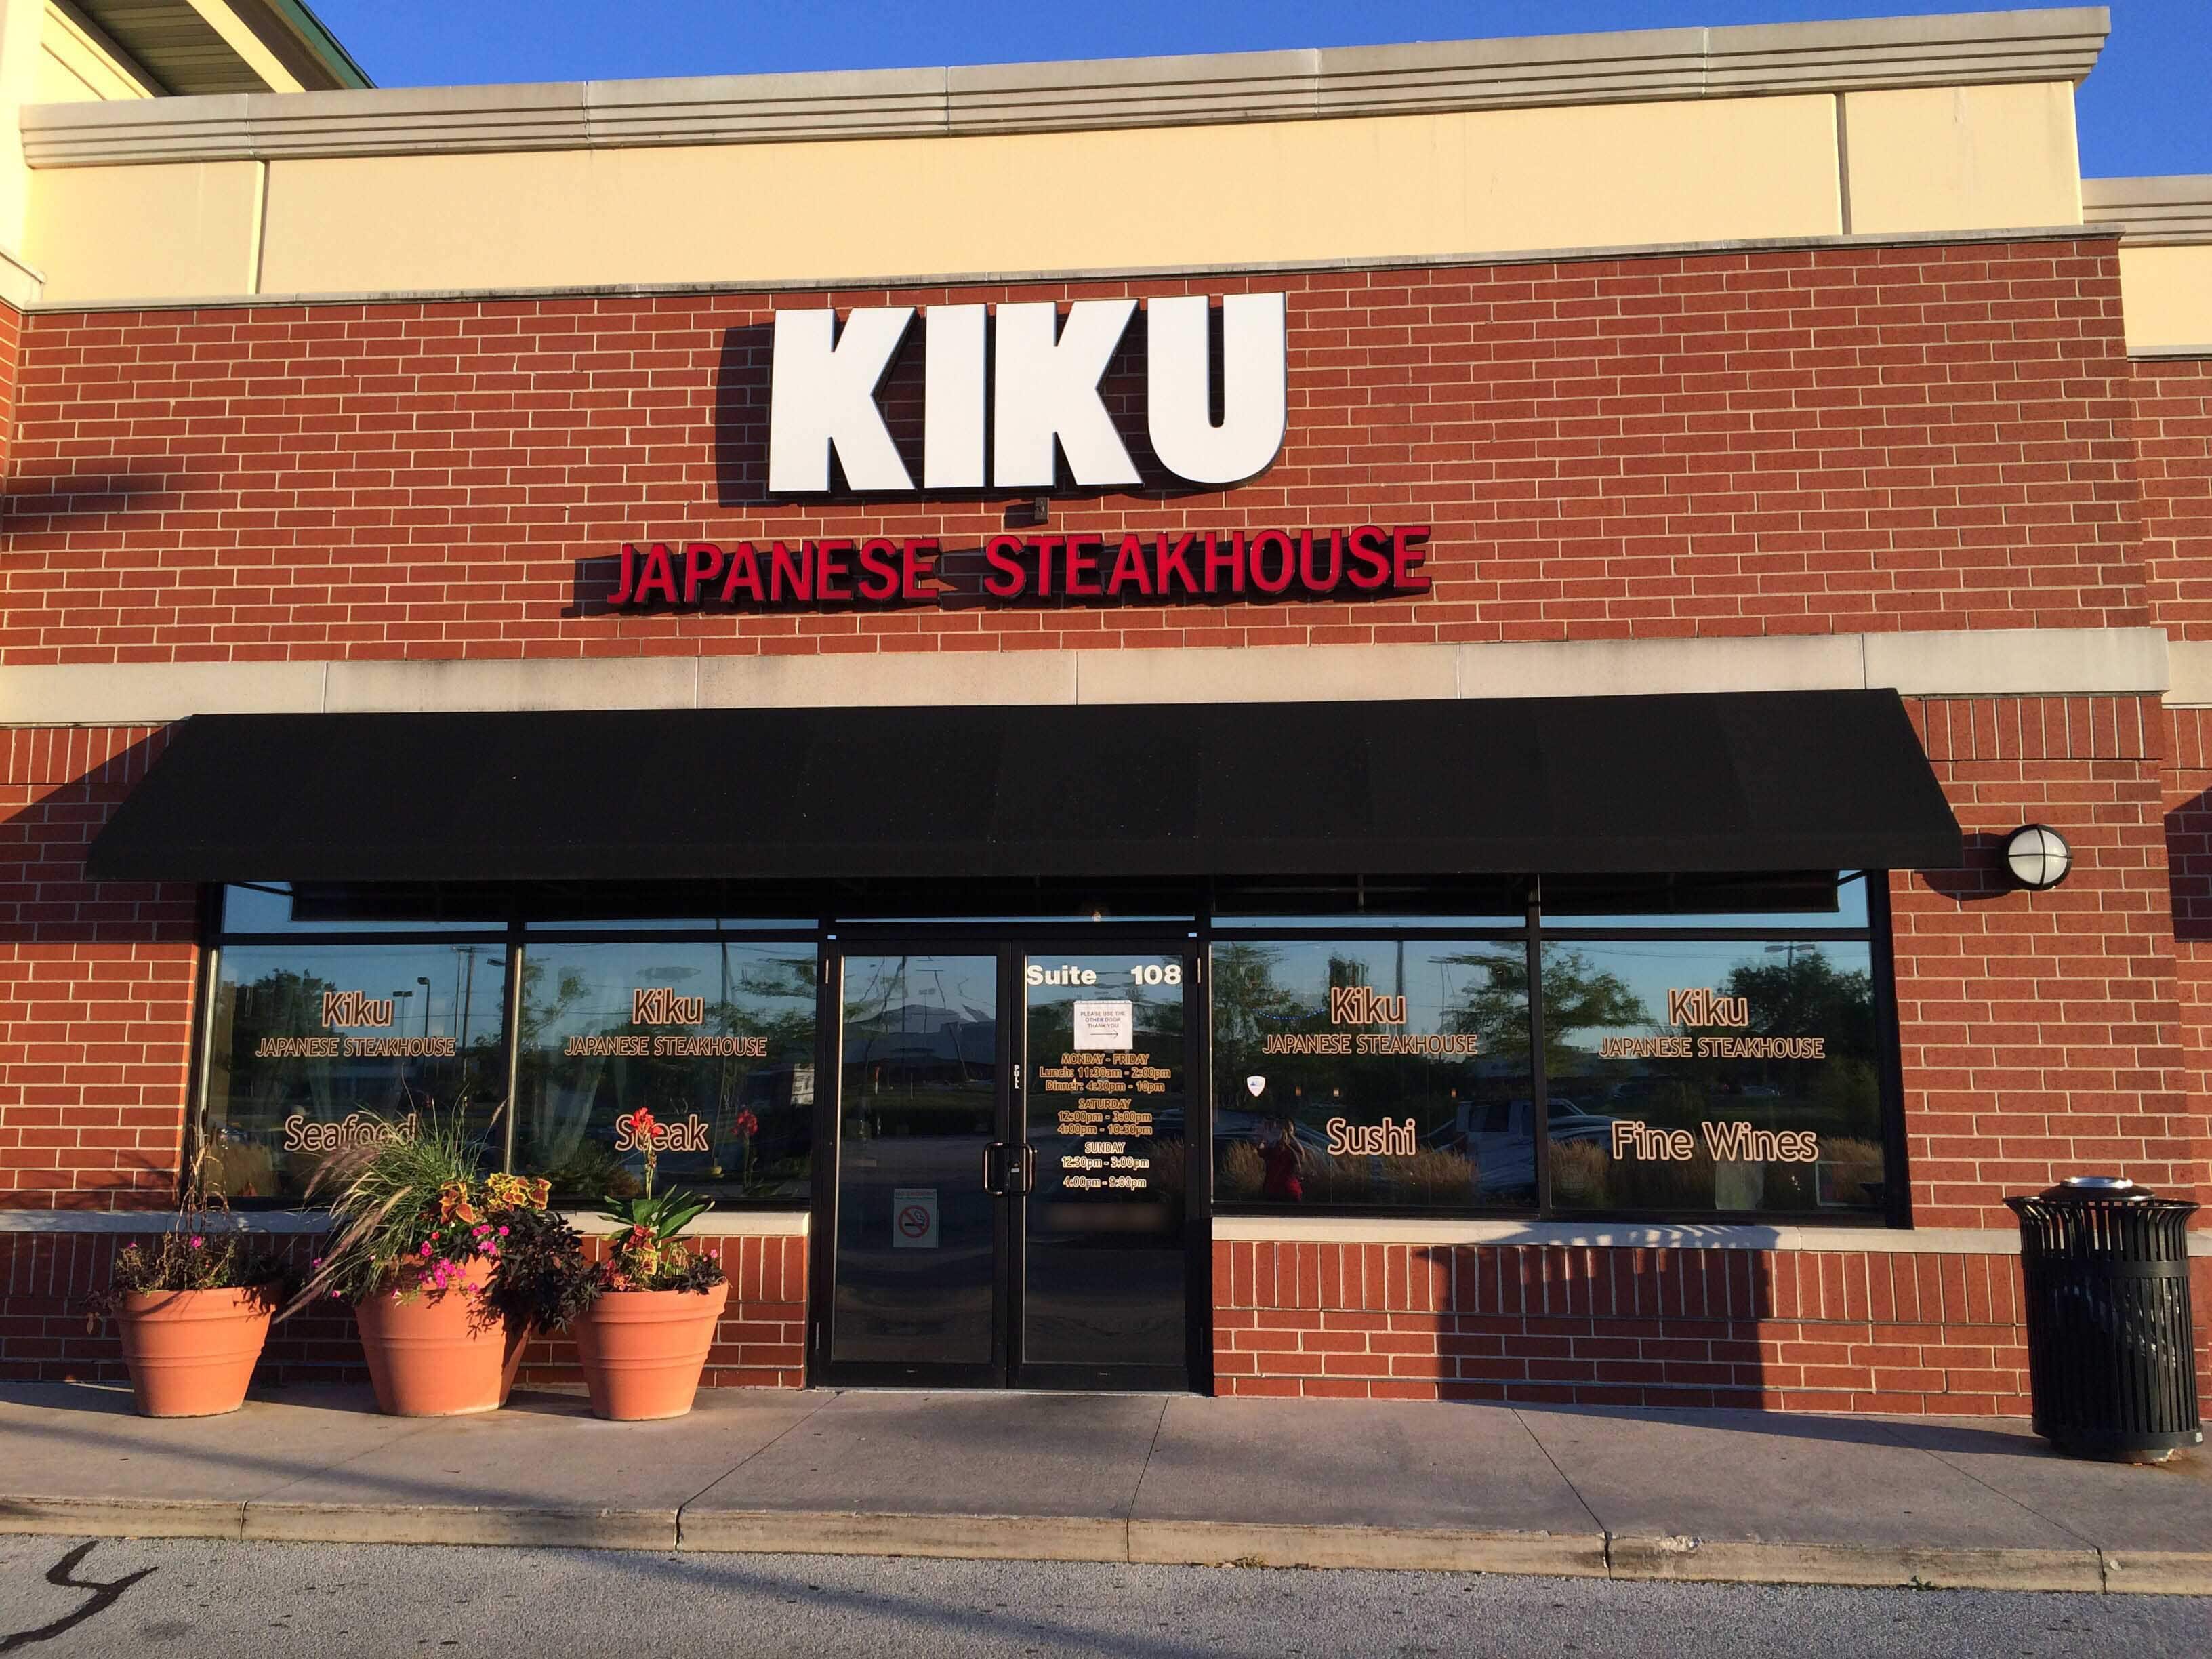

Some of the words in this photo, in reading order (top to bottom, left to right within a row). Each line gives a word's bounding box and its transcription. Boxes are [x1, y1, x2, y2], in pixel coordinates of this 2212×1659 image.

[768, 291, 1288, 493] KIKU
[607, 537, 941, 605] JAPANESE
[983, 525, 1432, 598] STEAKHOUSE
[1026, 965, 1097, 985] Suite
[1130, 964, 1182, 985] 108
[321, 990, 394, 1027] Kiku
[632, 987, 705, 1025] Kiku
[1330, 986, 1406, 1025] Kiku
[1667, 987, 1749, 1026] Kiku
[255, 1037, 339, 1057] JAPANESE
[343, 1037, 456, 1057] STEAKHOUSE
[564, 1036, 649, 1056] JAPANESE
[653, 1036, 767, 1057] STEAKHOUSE
[1262, 1034, 1352, 1054] JAPANESE
[1356, 1034, 1478, 1055] STEAKHOUSE
[1598, 1037, 1693, 1057] JAPANESE
[1697, 1037, 1826, 1059] STEAKHOUSE
[1061, 1053, 1105, 1065] MONDAY
[1113, 1053, 1150, 1065] FRIDAY
[1039, 1066, 1074, 1078] Lunch:
[1078, 1066, 1122, 1078] 11:30am
[1131, 1067, 1171, 1080] 2:00pm
[1046, 1080, 1084, 1091] Dinner:
[1086, 1080, 1126, 1093] 4:30pm
[1136, 1080, 1165, 1094] 10pm
[1078, 1098, 1132, 1109] SATURDAY
[1058, 1111, 1103, 1124] 12:00pm
[1112, 1111, 1152, 1124] 3:00pm
[283, 1113, 417, 1151] Seafood
[1057, 1123, 1097, 1136] 4:00pm
[1107, 1124, 1152, 1137] 10:30pm
[1326, 1117, 1416, 1155] Sushi
[1084, 1141, 1126, 1153] SUNDAY
[1612, 1120, 1694, 1161] Fine
[1702, 1121, 1819, 1162] Wines
[1061, 1156, 1103, 1170] 12:30pm
[1111, 1156, 1149, 1171] 3:00pm
[1063, 1176, 1101, 1191] 4:00pm
[1109, 1176, 1147, 1191] 9:00pm
